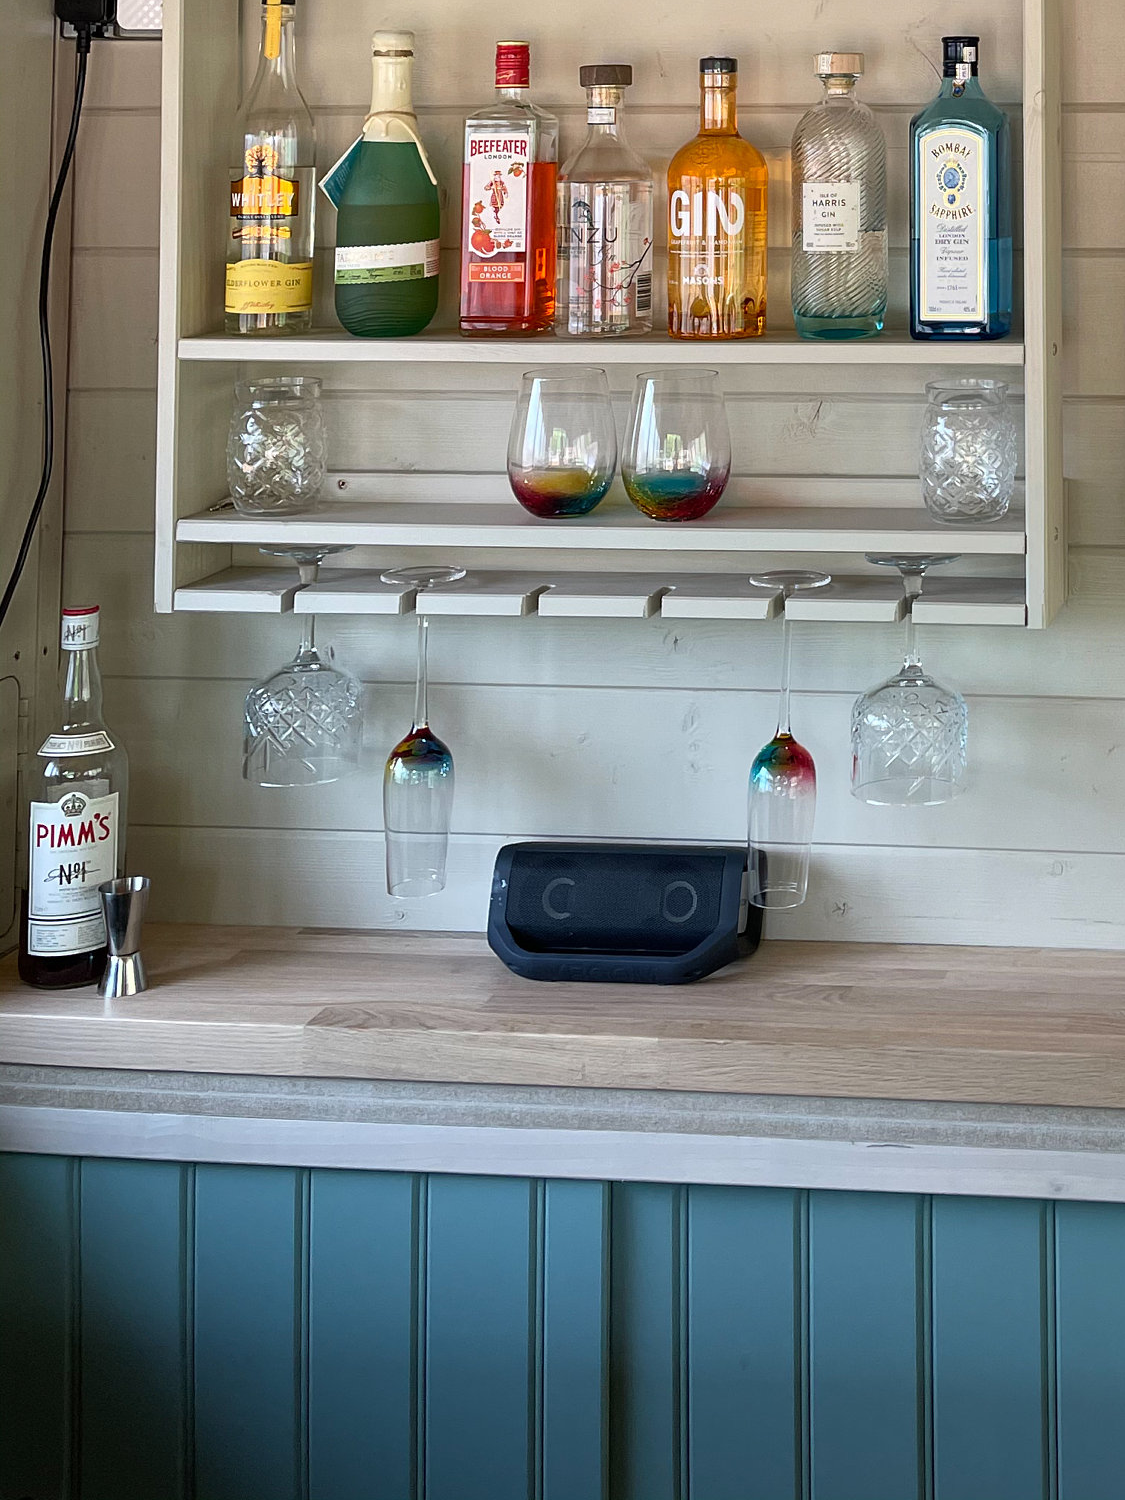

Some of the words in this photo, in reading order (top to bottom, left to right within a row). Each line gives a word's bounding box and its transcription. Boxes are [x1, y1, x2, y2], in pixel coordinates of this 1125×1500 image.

[470, 140, 527, 157] BEEFEATER
[931, 142, 972, 158] BOMBAY
[231, 192, 295, 207] WHITLEY
[812, 199, 846, 207] HARRIS
[929, 203, 973, 220] SAPPHIRE
[285, 279, 301, 287] GIN
[682, 276, 724, 285] MASONS
[37, 812, 110, 848] PIMM'S
